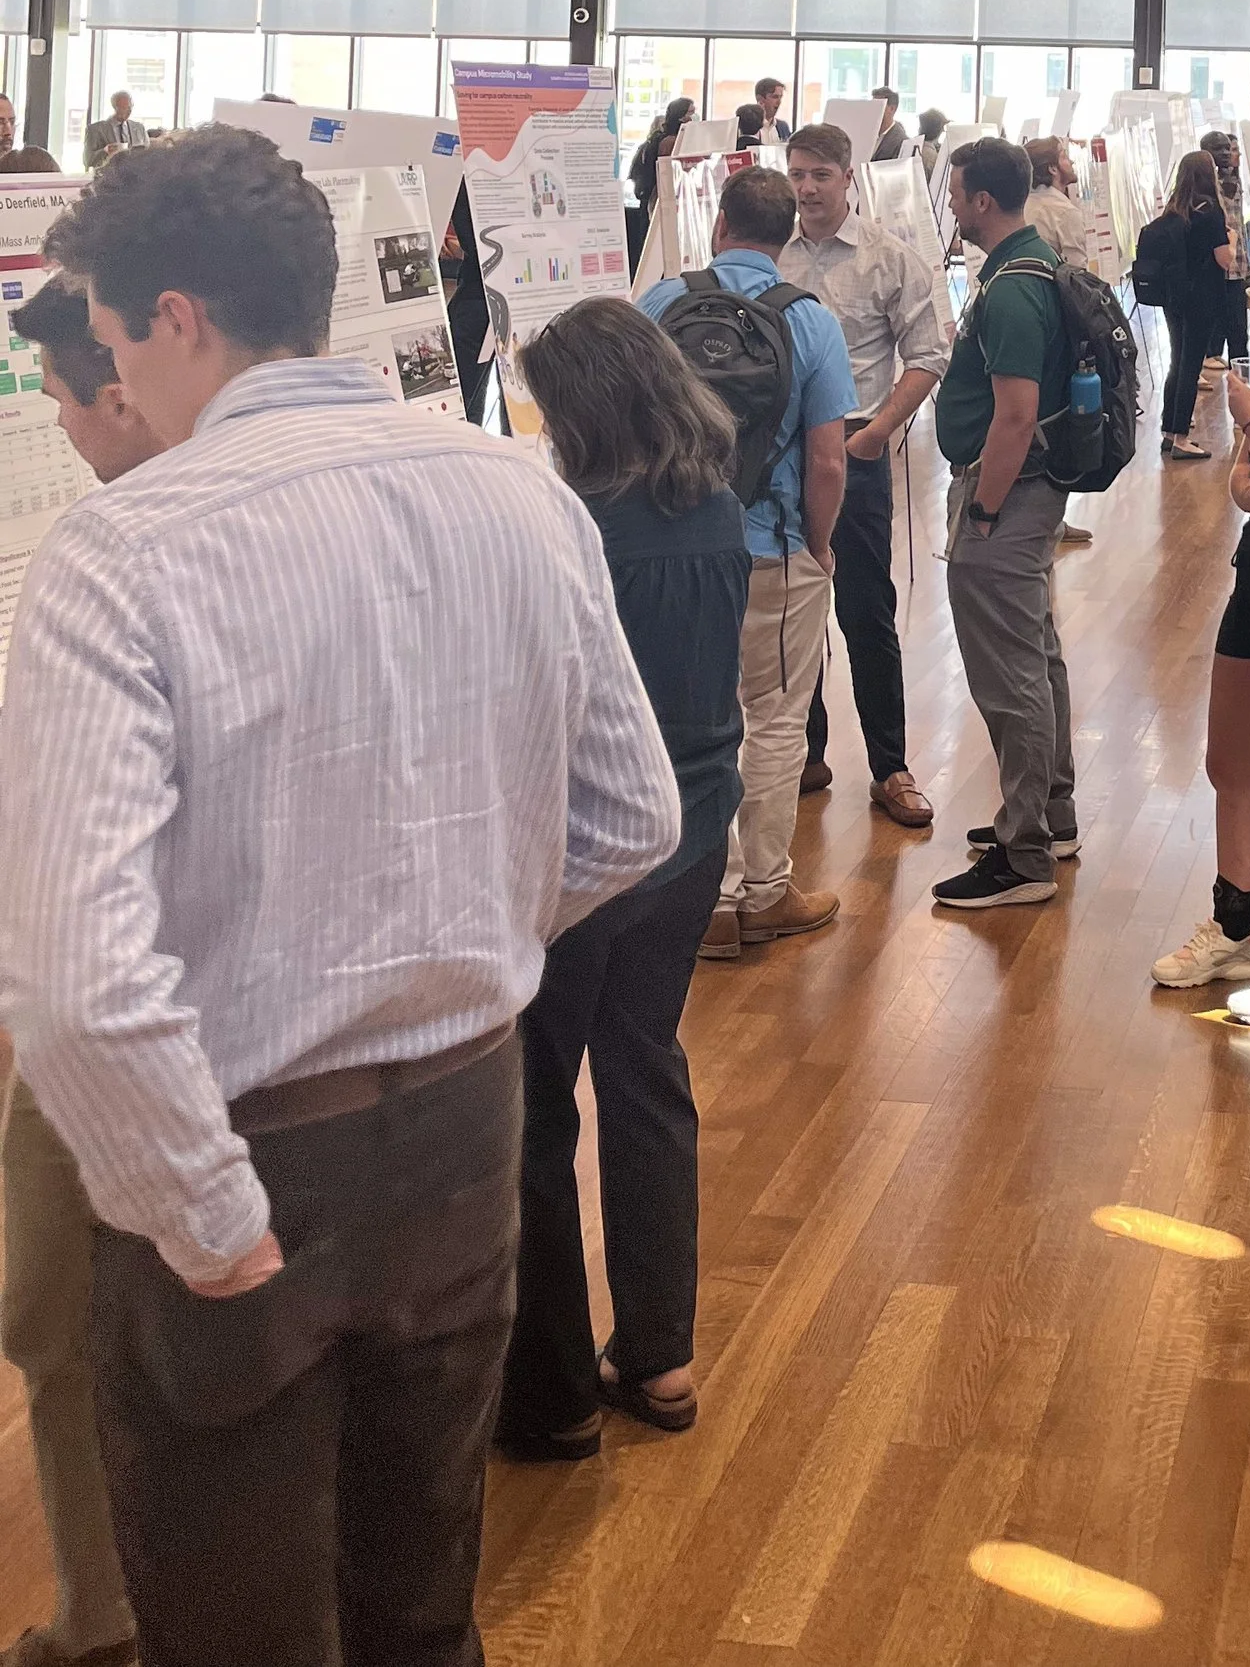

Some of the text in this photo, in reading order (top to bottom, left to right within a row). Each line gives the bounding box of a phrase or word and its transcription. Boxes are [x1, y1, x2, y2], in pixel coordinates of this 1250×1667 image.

[455, 68, 532, 81] Campus Micromobility Study
[5, 196, 49, 210] Deerfield,
